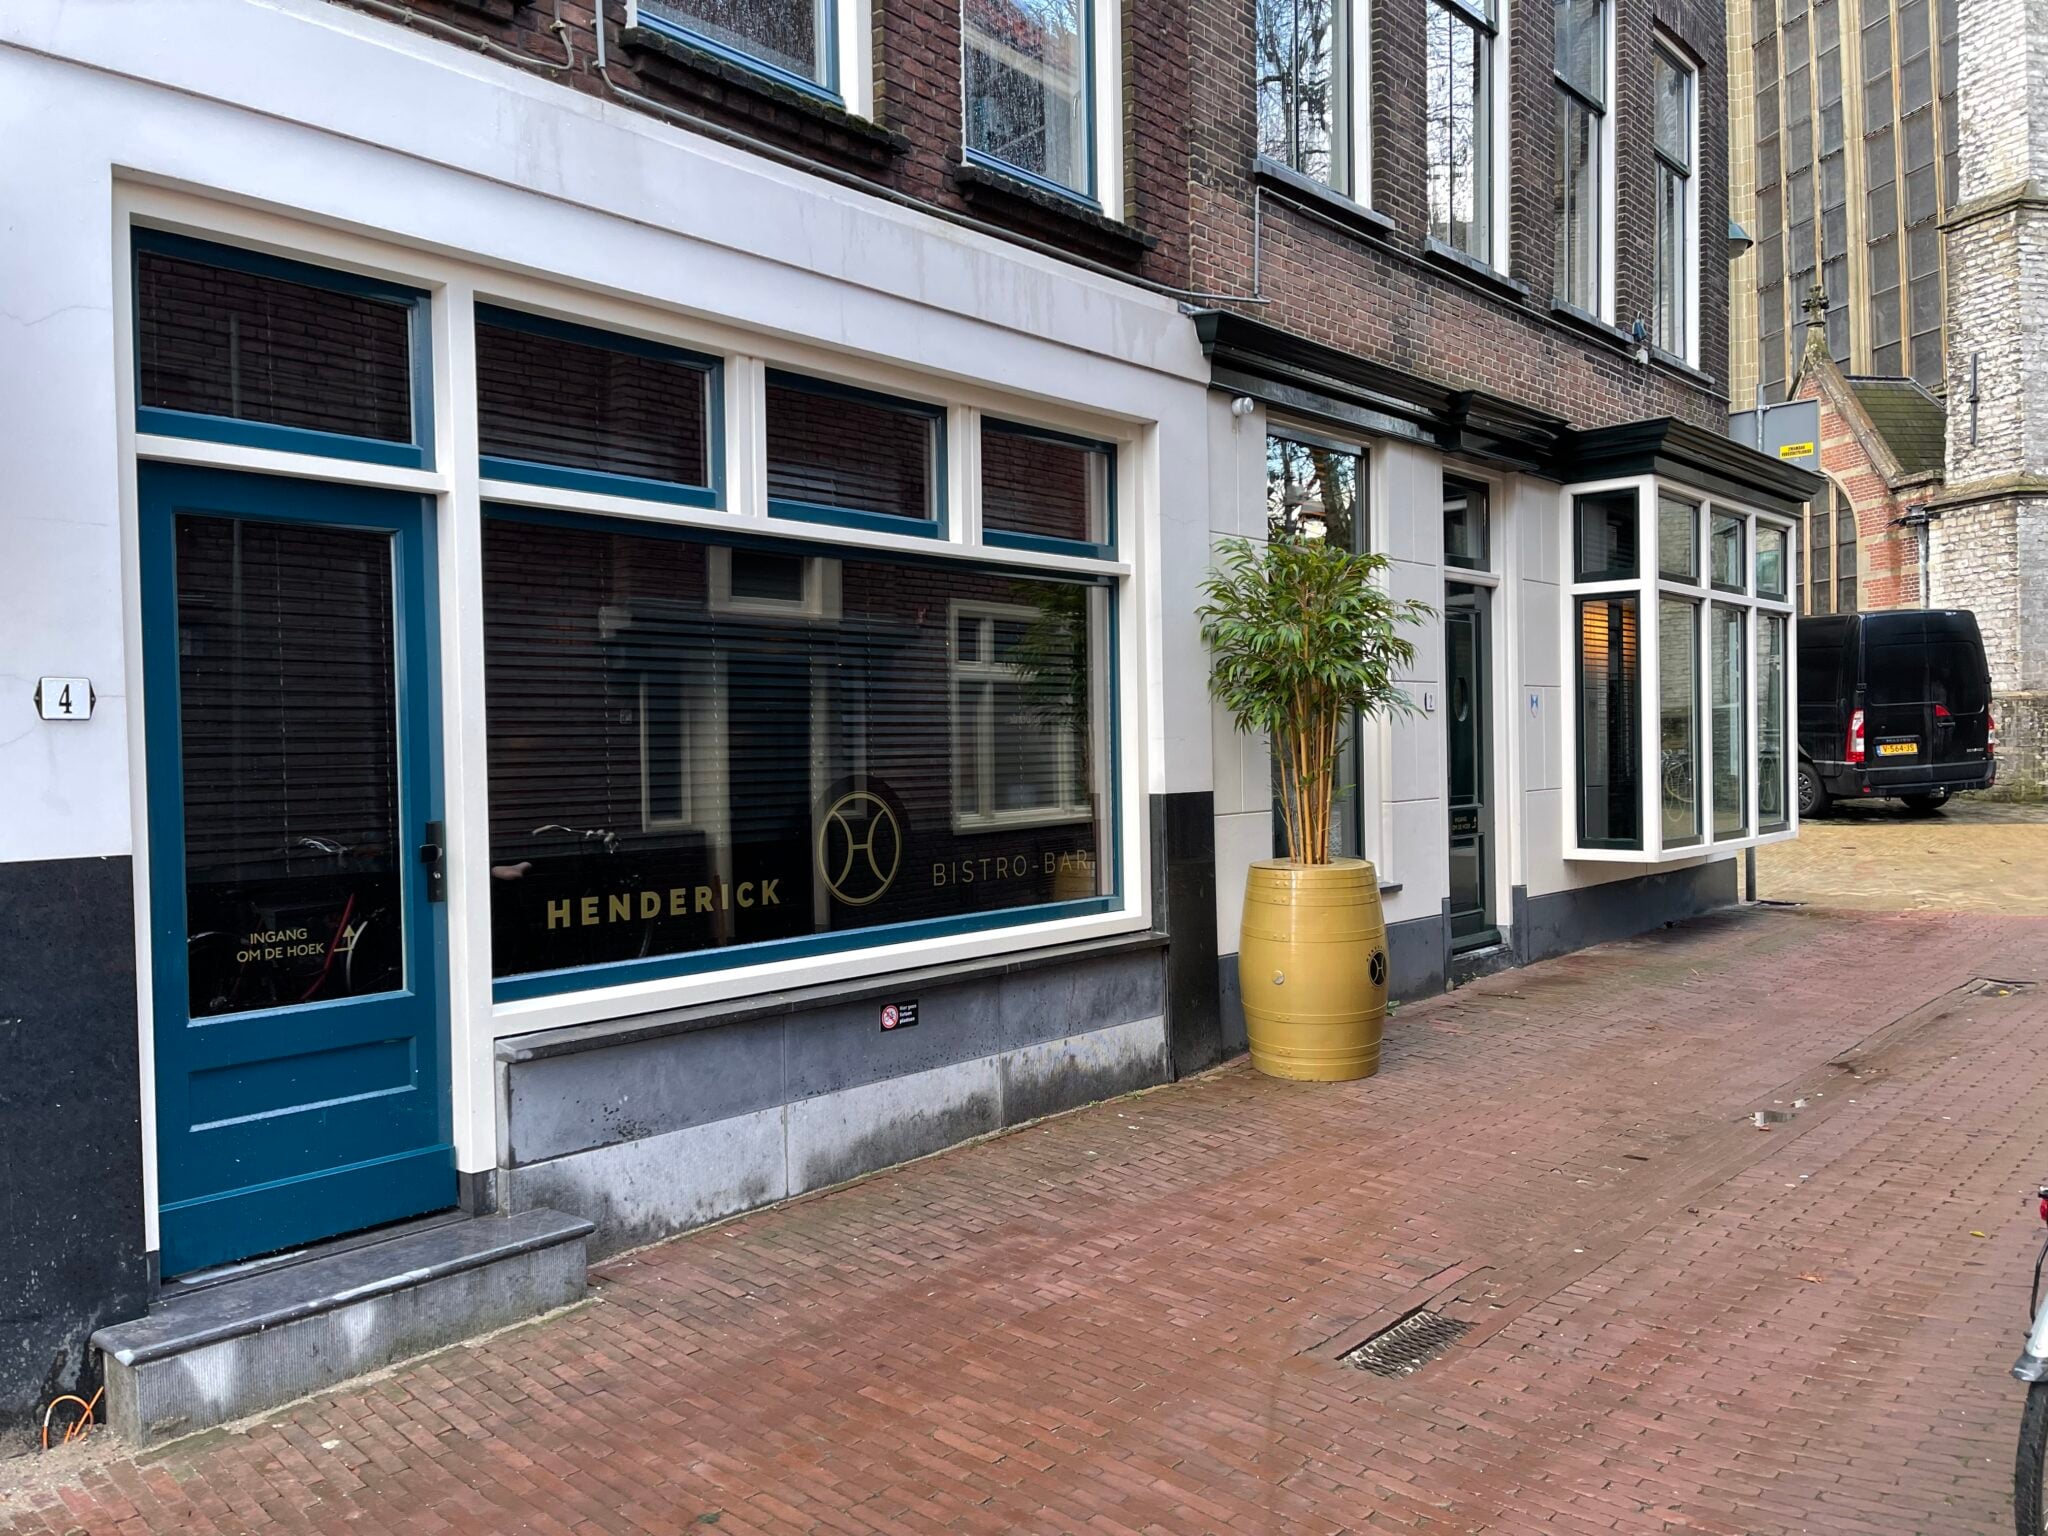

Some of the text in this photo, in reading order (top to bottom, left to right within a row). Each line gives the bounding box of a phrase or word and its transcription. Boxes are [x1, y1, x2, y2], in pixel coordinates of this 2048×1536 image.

[58, 683, 73, 714] 4
[933, 849, 1090, 887] BISTRO-BAR
[547, 878, 781, 930] HENDERICK
[250, 928, 308, 945] INGANG
[236, 943, 325, 963] OM DE HOEK
